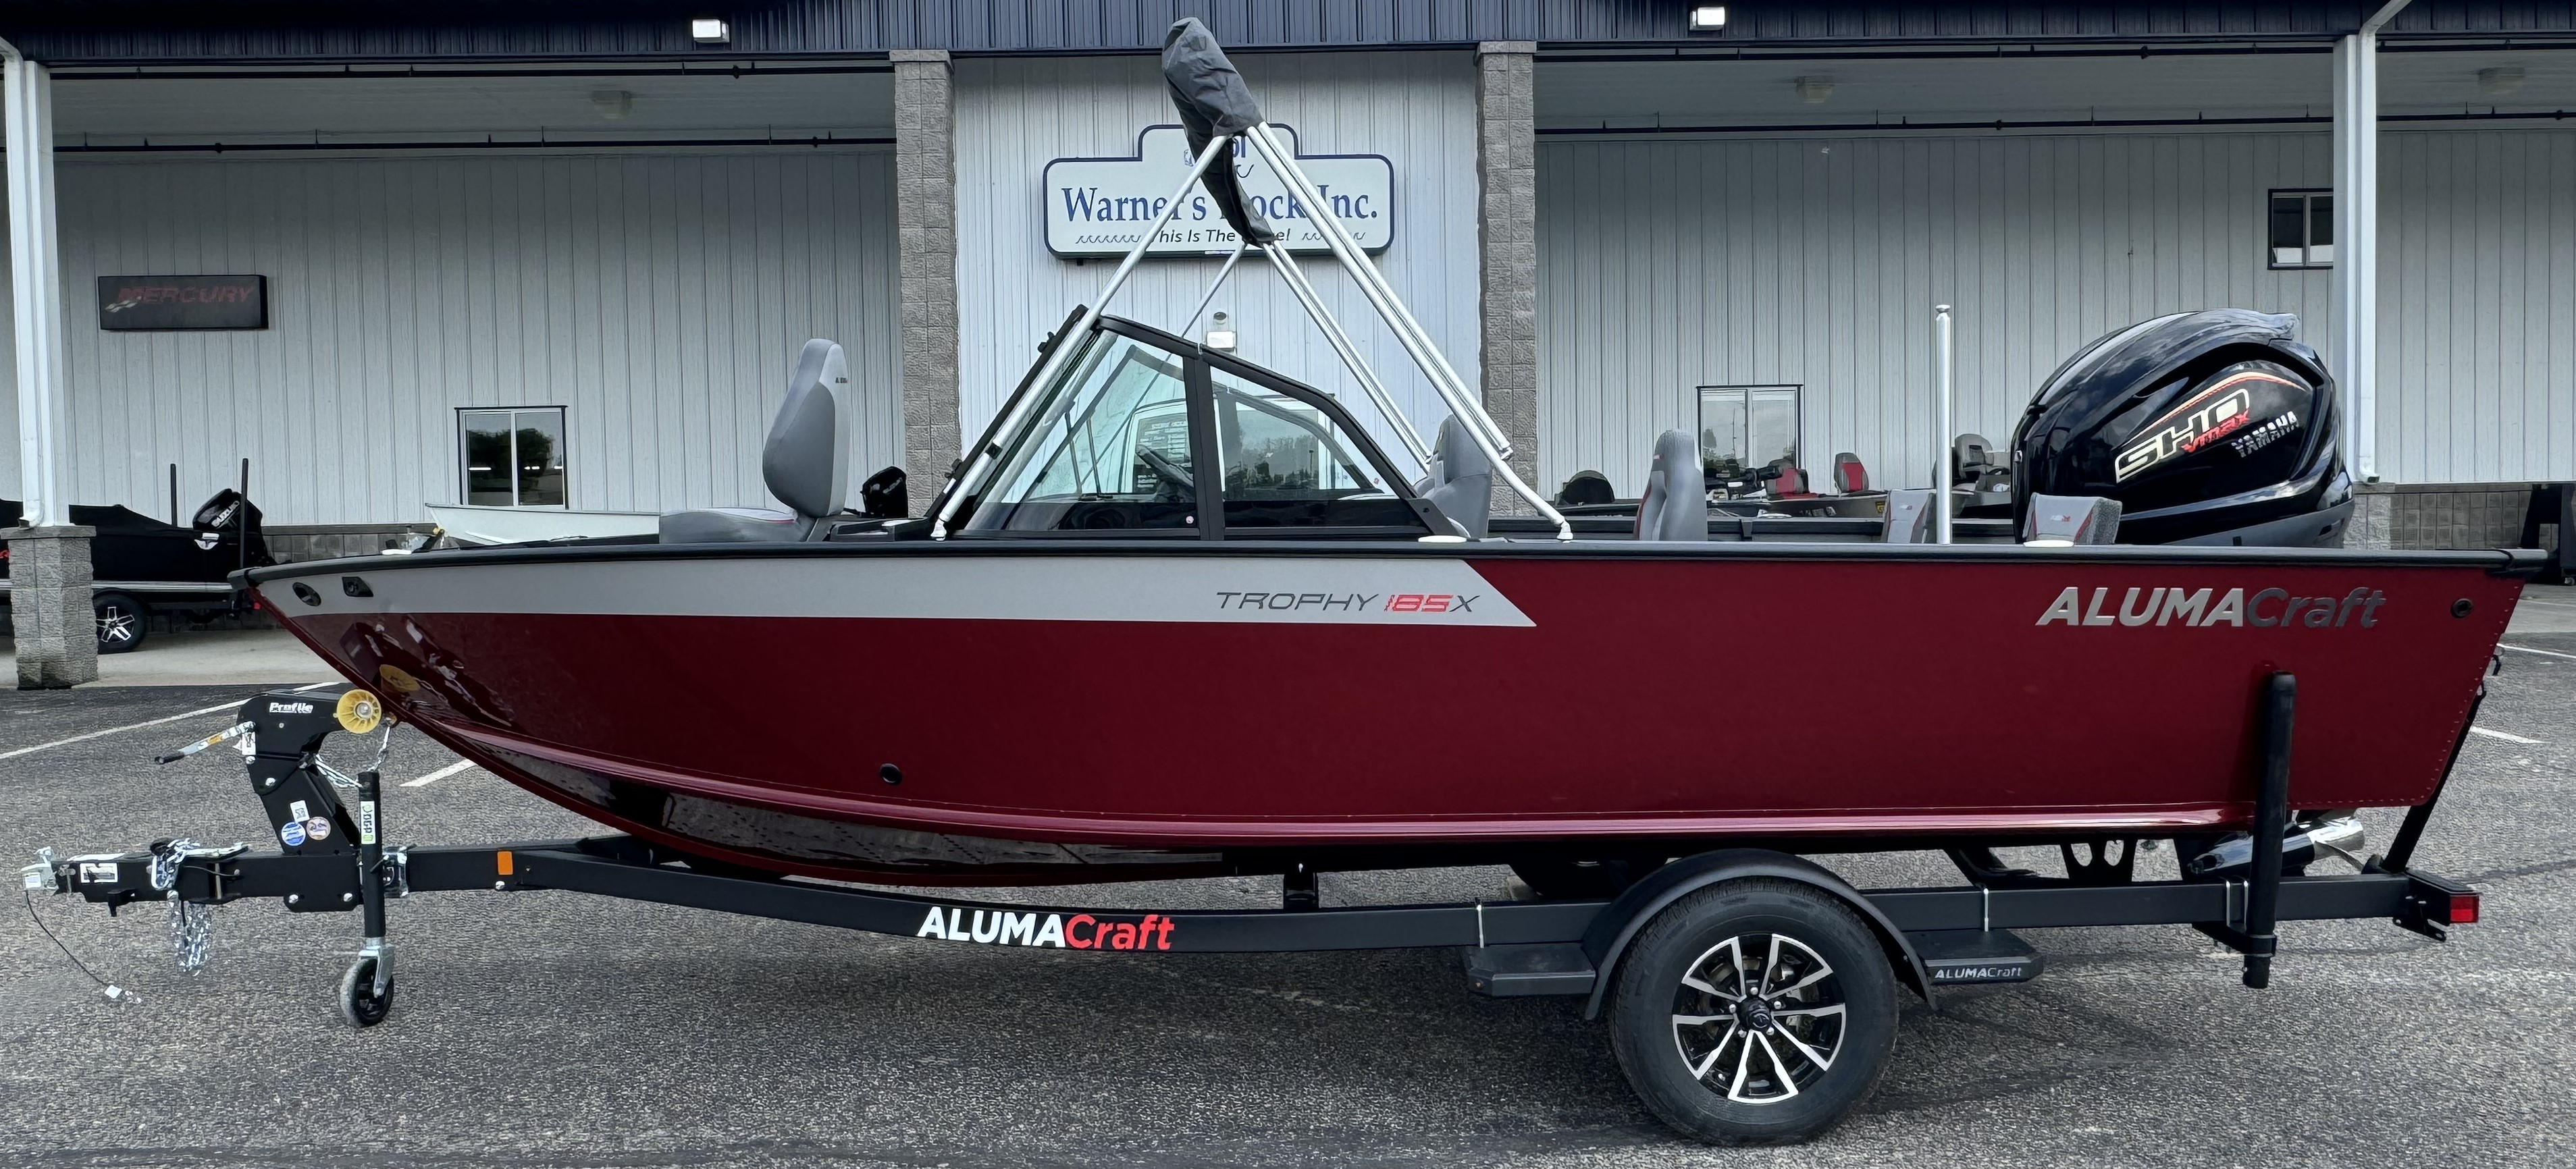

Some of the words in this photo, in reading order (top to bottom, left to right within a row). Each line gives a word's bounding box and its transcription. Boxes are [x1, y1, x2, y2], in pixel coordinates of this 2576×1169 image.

[1159, 229, 1182, 242] his
[1188, 229, 1200, 242] Is
[1205, 229, 1236, 242] The
[117, 286, 253, 304] MERCURY
[2115, 388, 2250, 483] SHO
[2231, 410, 2299, 458] YAMAHA
[1216, 592, 1379, 611] TROPHY
[2034, 587, 2387, 628] ALUMACraft
[916, 906, 1175, 950] ALUMACraft
[1935, 967, 2022, 979] ALUMACraft
